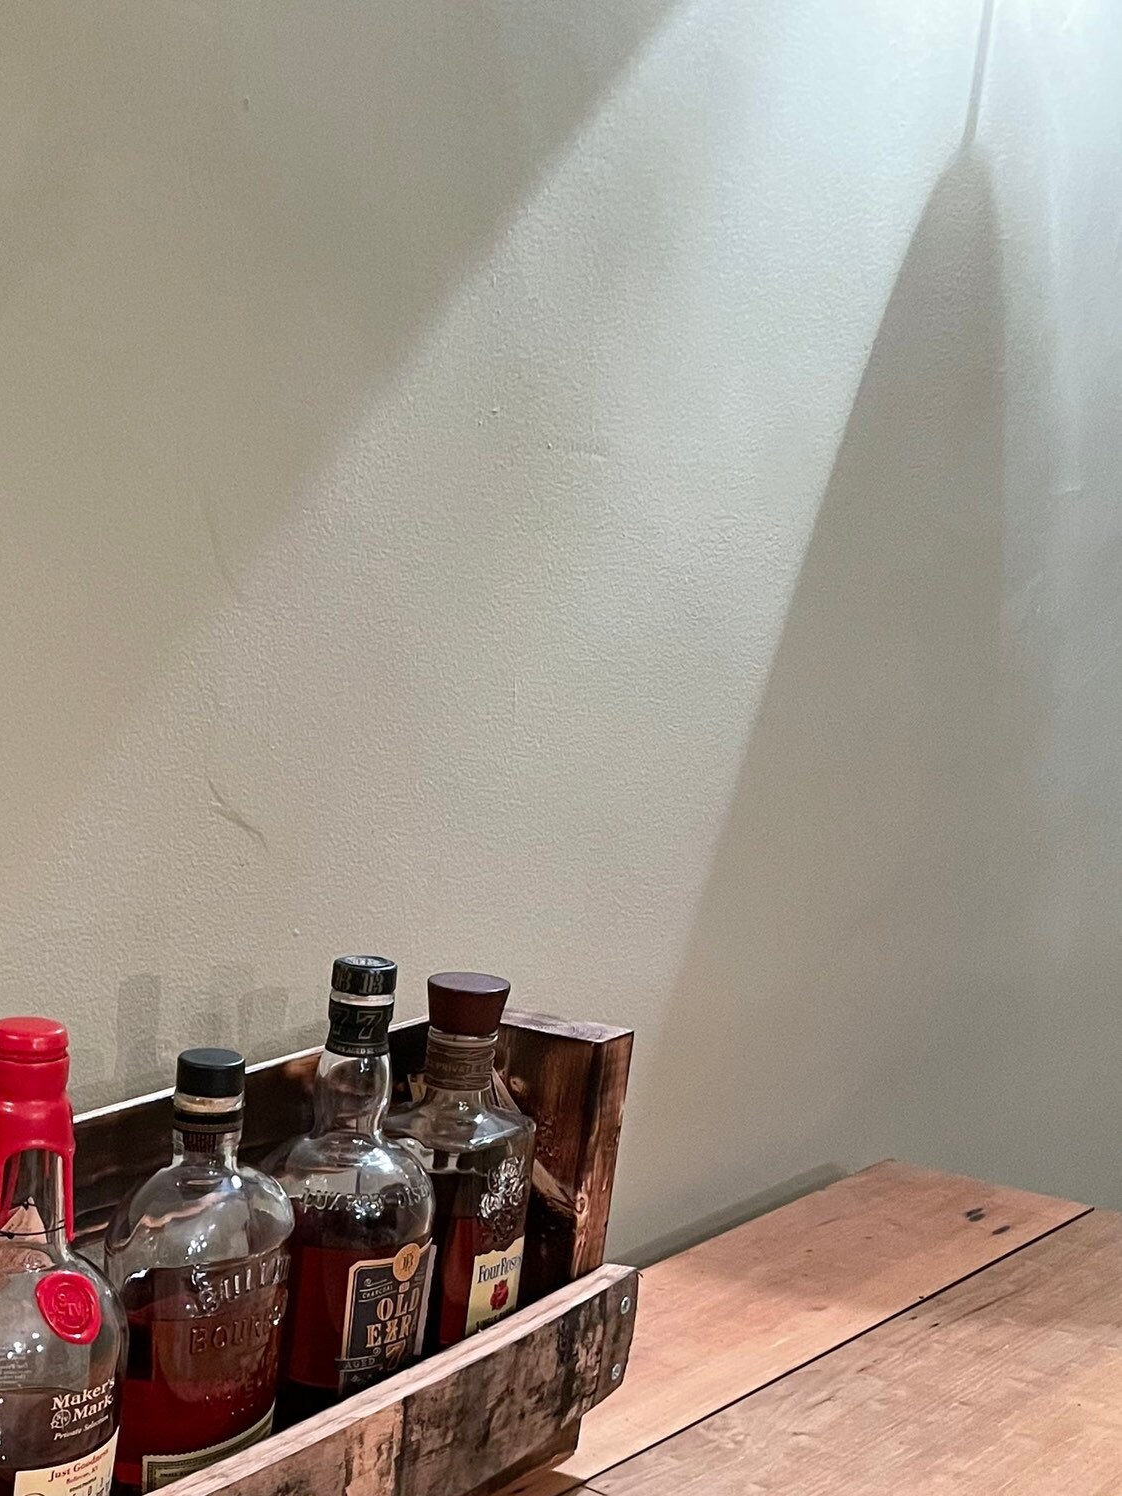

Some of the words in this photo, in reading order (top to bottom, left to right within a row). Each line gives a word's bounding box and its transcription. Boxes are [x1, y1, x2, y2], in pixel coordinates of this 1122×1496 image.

[357, 1010, 383, 1040] 7
[477, 1262, 501, 1284] Four
[376, 1287, 420, 1321] OLD
[344, 1357, 376, 1369] AGED
[50, 1376, 115, 1411] Maker's
[48, 1469, 71, 1482] Just
